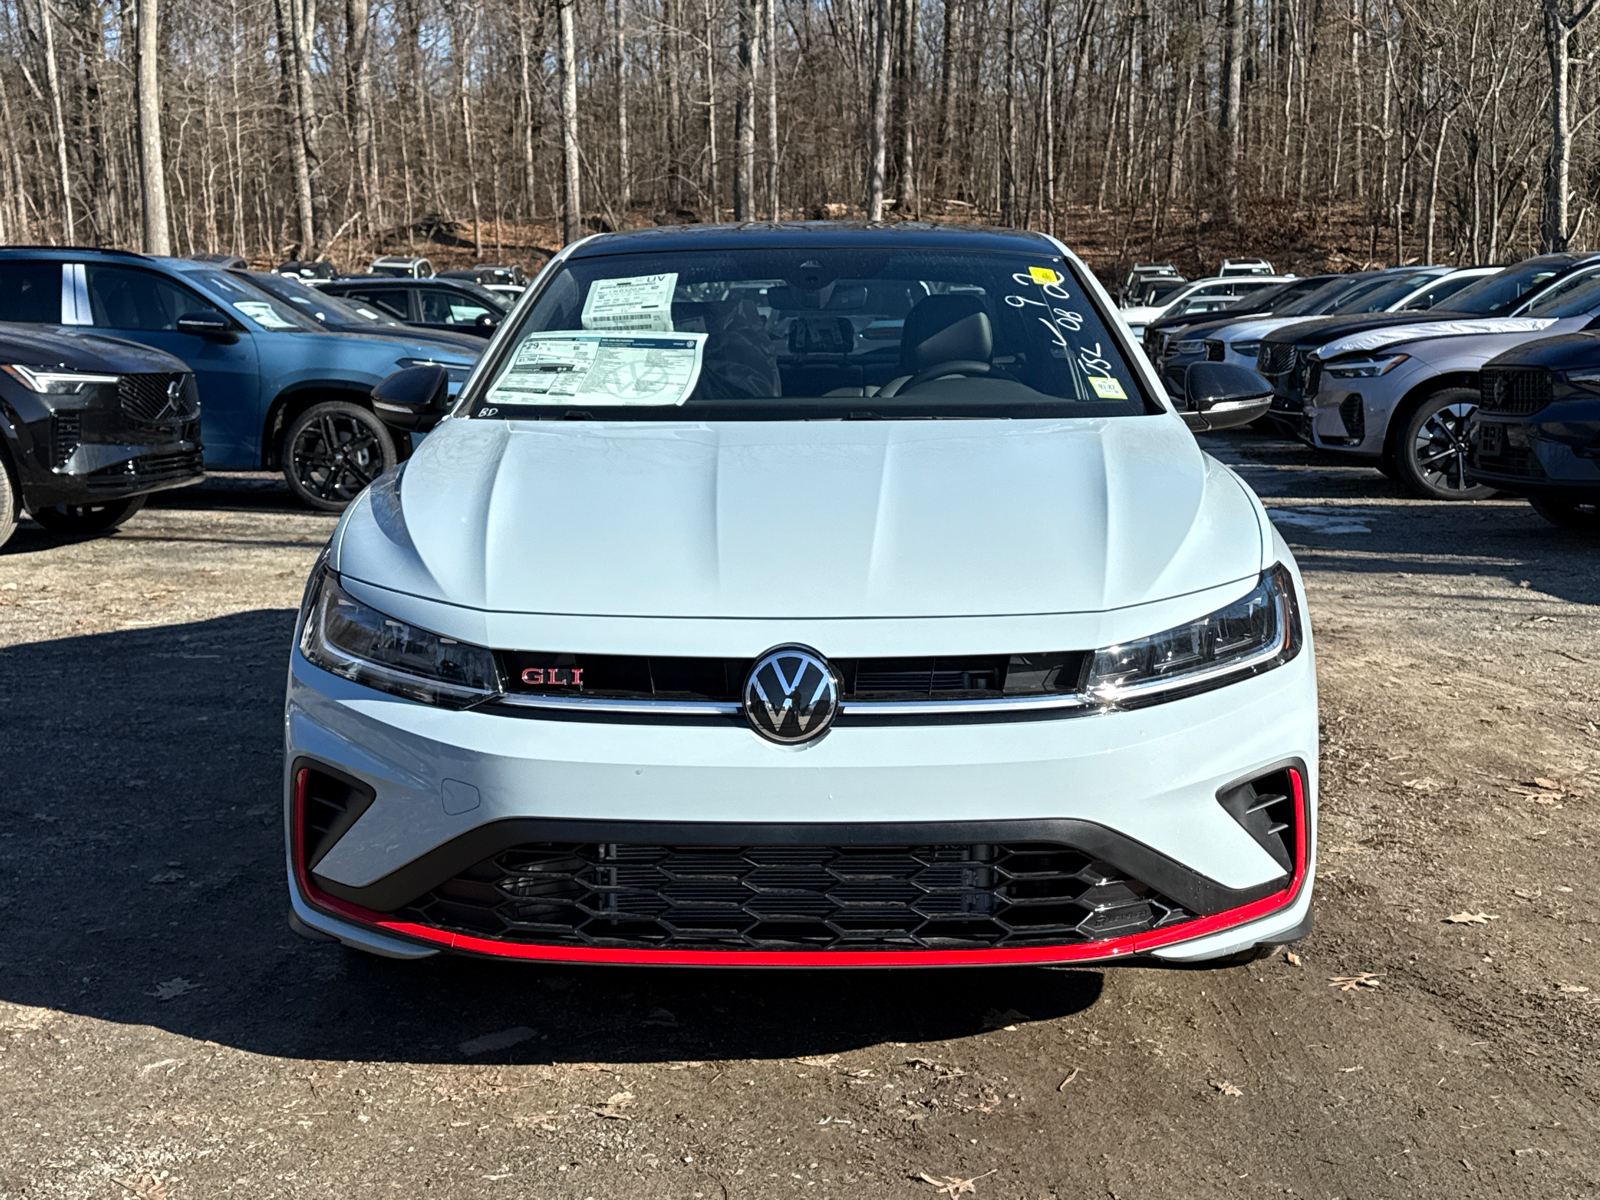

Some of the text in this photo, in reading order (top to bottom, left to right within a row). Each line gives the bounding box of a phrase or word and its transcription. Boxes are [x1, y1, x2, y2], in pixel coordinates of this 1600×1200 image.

[647, 275, 666, 283] UV
[477, 407, 499, 418] BD
[521, 667, 584, 685] GLI
